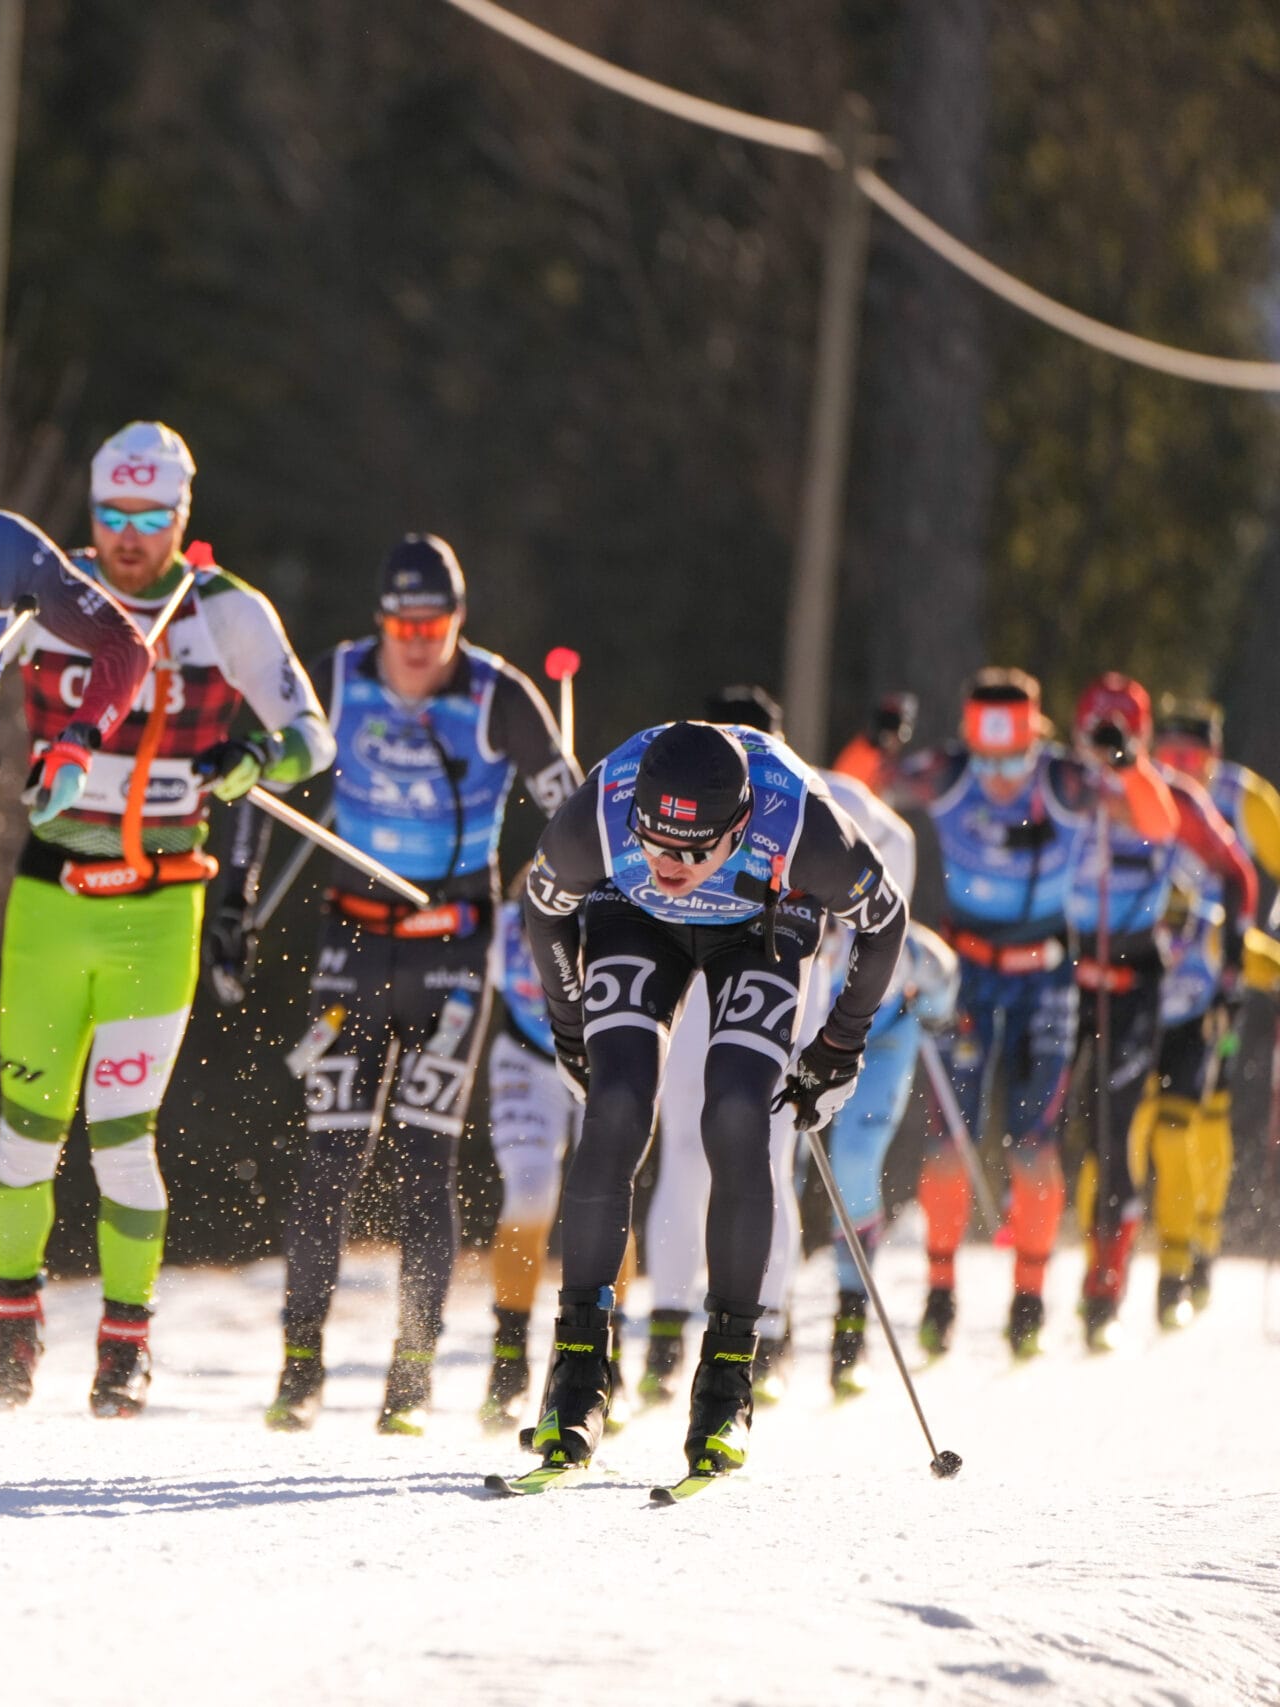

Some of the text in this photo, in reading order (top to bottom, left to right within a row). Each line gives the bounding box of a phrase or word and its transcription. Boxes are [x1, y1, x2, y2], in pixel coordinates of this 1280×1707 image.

[656, 821, 715, 838] Moelven
[714, 970, 801, 1033] 157
[555, 1342, 595, 1353] CHER
[713, 1351, 755, 1363] FISC
